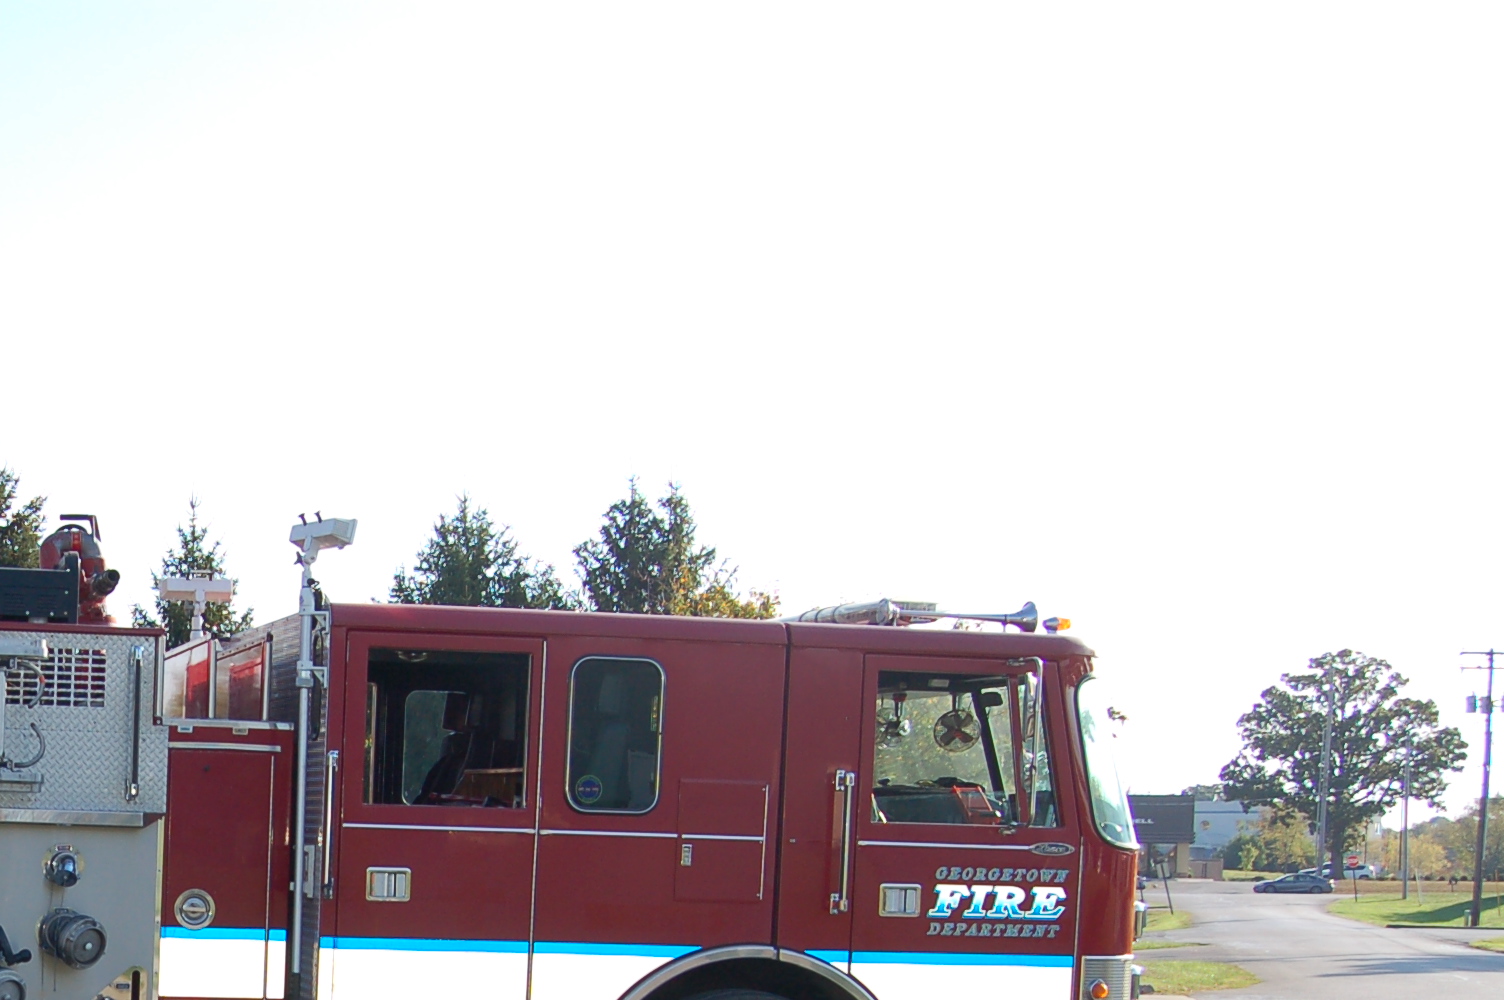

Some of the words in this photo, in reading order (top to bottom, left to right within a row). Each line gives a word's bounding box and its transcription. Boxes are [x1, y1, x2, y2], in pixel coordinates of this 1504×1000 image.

[935, 866, 1069, 883] GEORGETOWN
[926, 883, 1067, 921] FIRE
[926, 922, 1061, 938] DEPARTMENT
